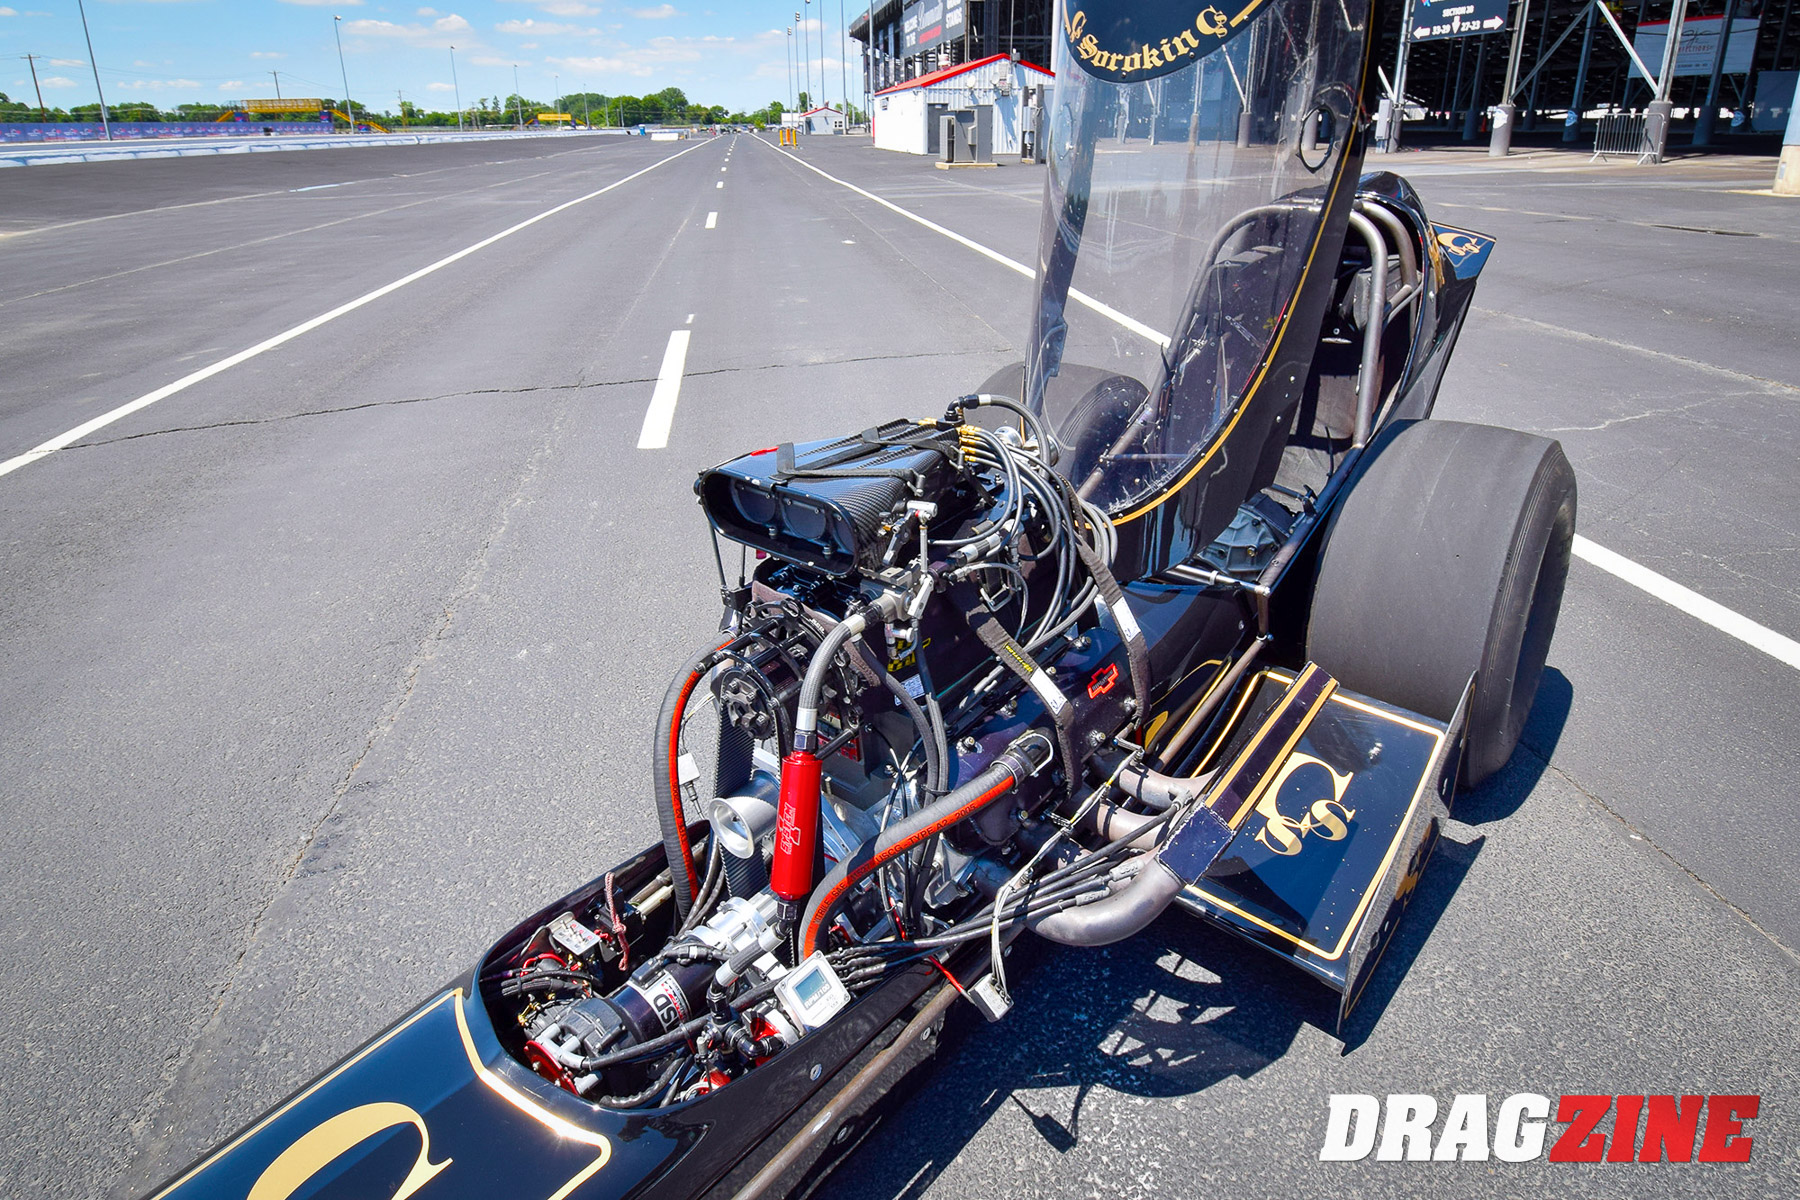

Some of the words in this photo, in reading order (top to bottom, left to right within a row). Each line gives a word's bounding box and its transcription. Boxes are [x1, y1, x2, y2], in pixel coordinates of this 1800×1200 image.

[1076, 28, 1200, 73] Sorokin
[874, 844, 904, 864] USCG
[909, 826, 934, 844] TYPE
[936, 819, 949, 830] A2
